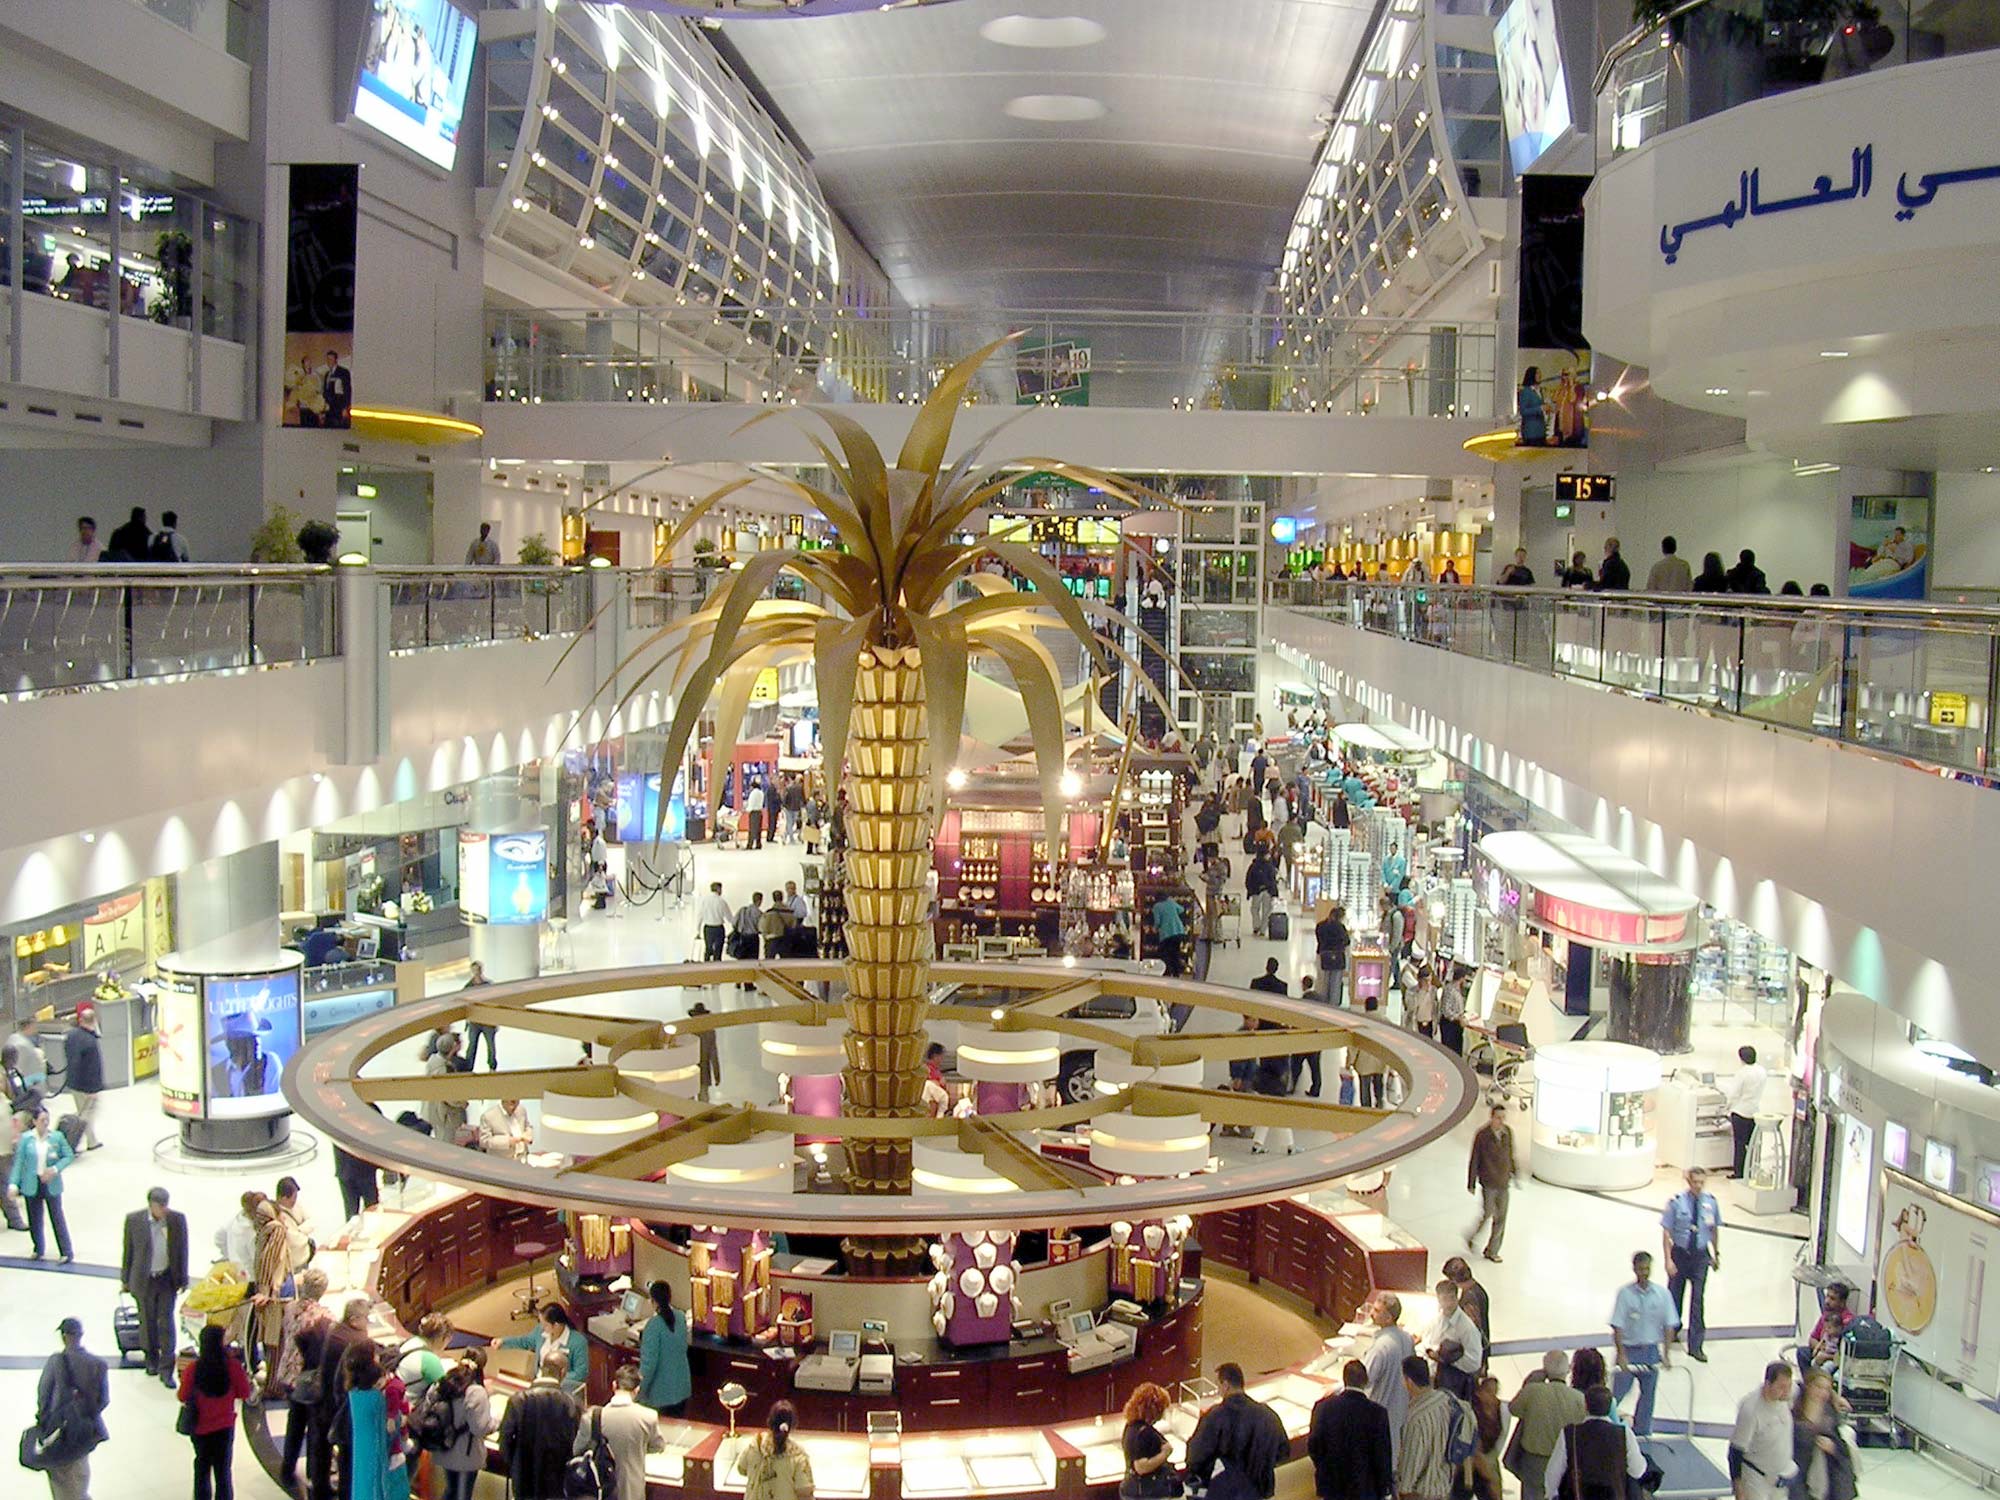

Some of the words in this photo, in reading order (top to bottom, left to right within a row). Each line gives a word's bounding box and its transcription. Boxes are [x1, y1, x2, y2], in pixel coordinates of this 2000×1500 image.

[1660, 143, 1873, 264] العالمي
[1575, 478, 1591, 499] 15
[1036, 522, 1044, 536] 1
[1057, 522, 1074, 536] 15
[120, 918, 129, 941] Z
[94, 933, 105, 957] A
